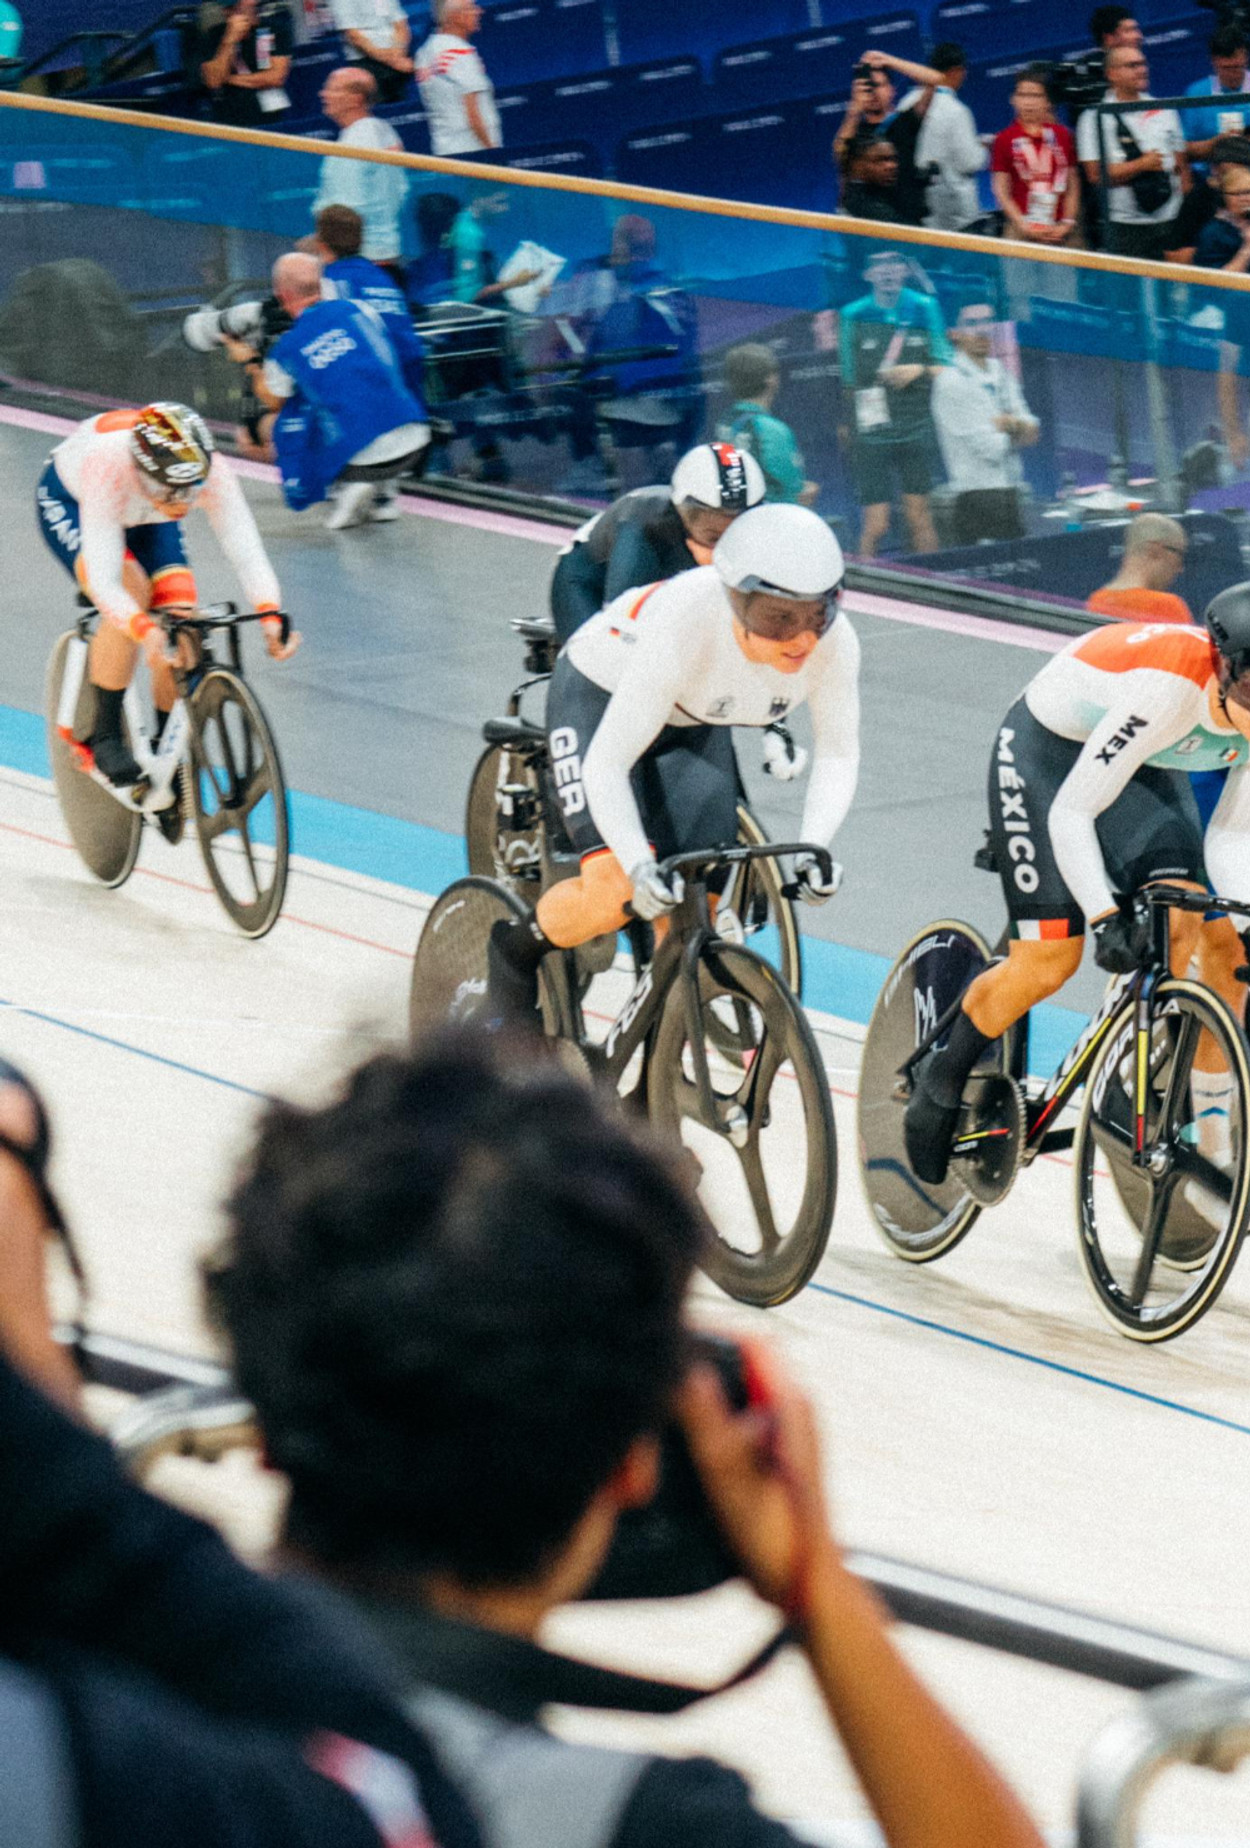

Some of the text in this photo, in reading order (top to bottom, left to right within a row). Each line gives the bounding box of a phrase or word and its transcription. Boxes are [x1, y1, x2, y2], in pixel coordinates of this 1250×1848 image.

[549, 726, 586, 817] GER
[1095, 714, 1149, 767] MEX
[993, 726, 1040, 895] MÉXICO
